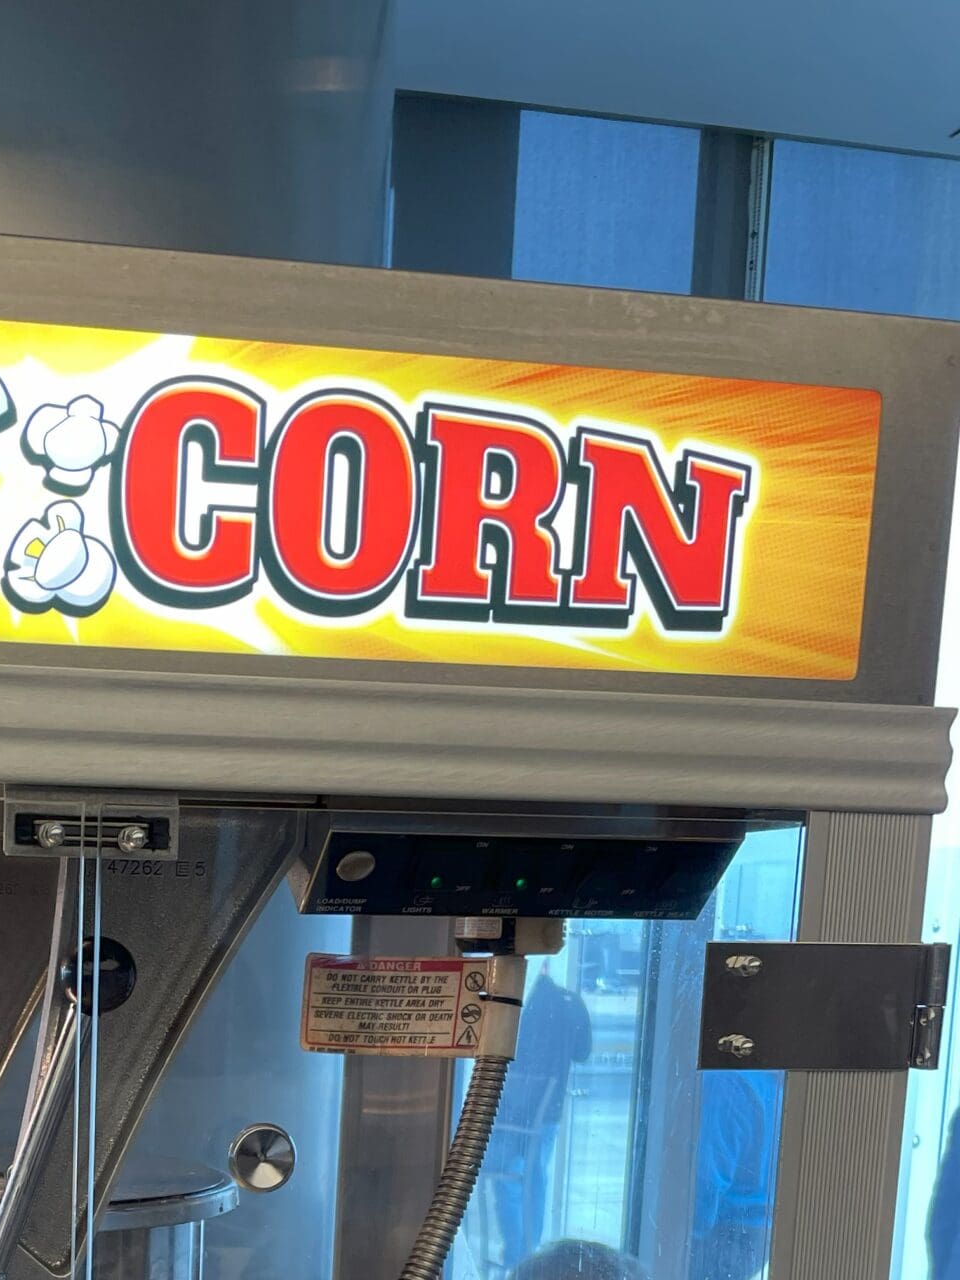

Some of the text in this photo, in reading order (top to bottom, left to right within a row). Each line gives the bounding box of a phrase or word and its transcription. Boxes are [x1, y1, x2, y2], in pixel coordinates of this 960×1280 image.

[111, 375, 751, 631] CORN
[108, 860, 162, 875] 47262
[195, 862, 205, 876] 5
[371, 962, 421, 971] DANGER
[361, 975, 386, 983] CARRY
[390, 976, 417, 984] KETTLE
[434, 976, 448, 984] THE
[332, 984, 368, 992] FLEXIBLE
[371, 985, 404, 993] CONDUIT
[421, 986, 442, 994] PLUG
[345, 998, 372, 1006] ENTIRE
[375, 999, 402, 1007] KETTLE
[314, 1010, 344, 1019] SEVERE
[347, 1011, 384, 1020] ELECTRIC
[358, 1022, 377, 1030] MAY
[328, 1034, 341, 1042] DO
[344, 1034, 360, 1042] NOT
[364, 1035, 388, 1043] TOUCH
